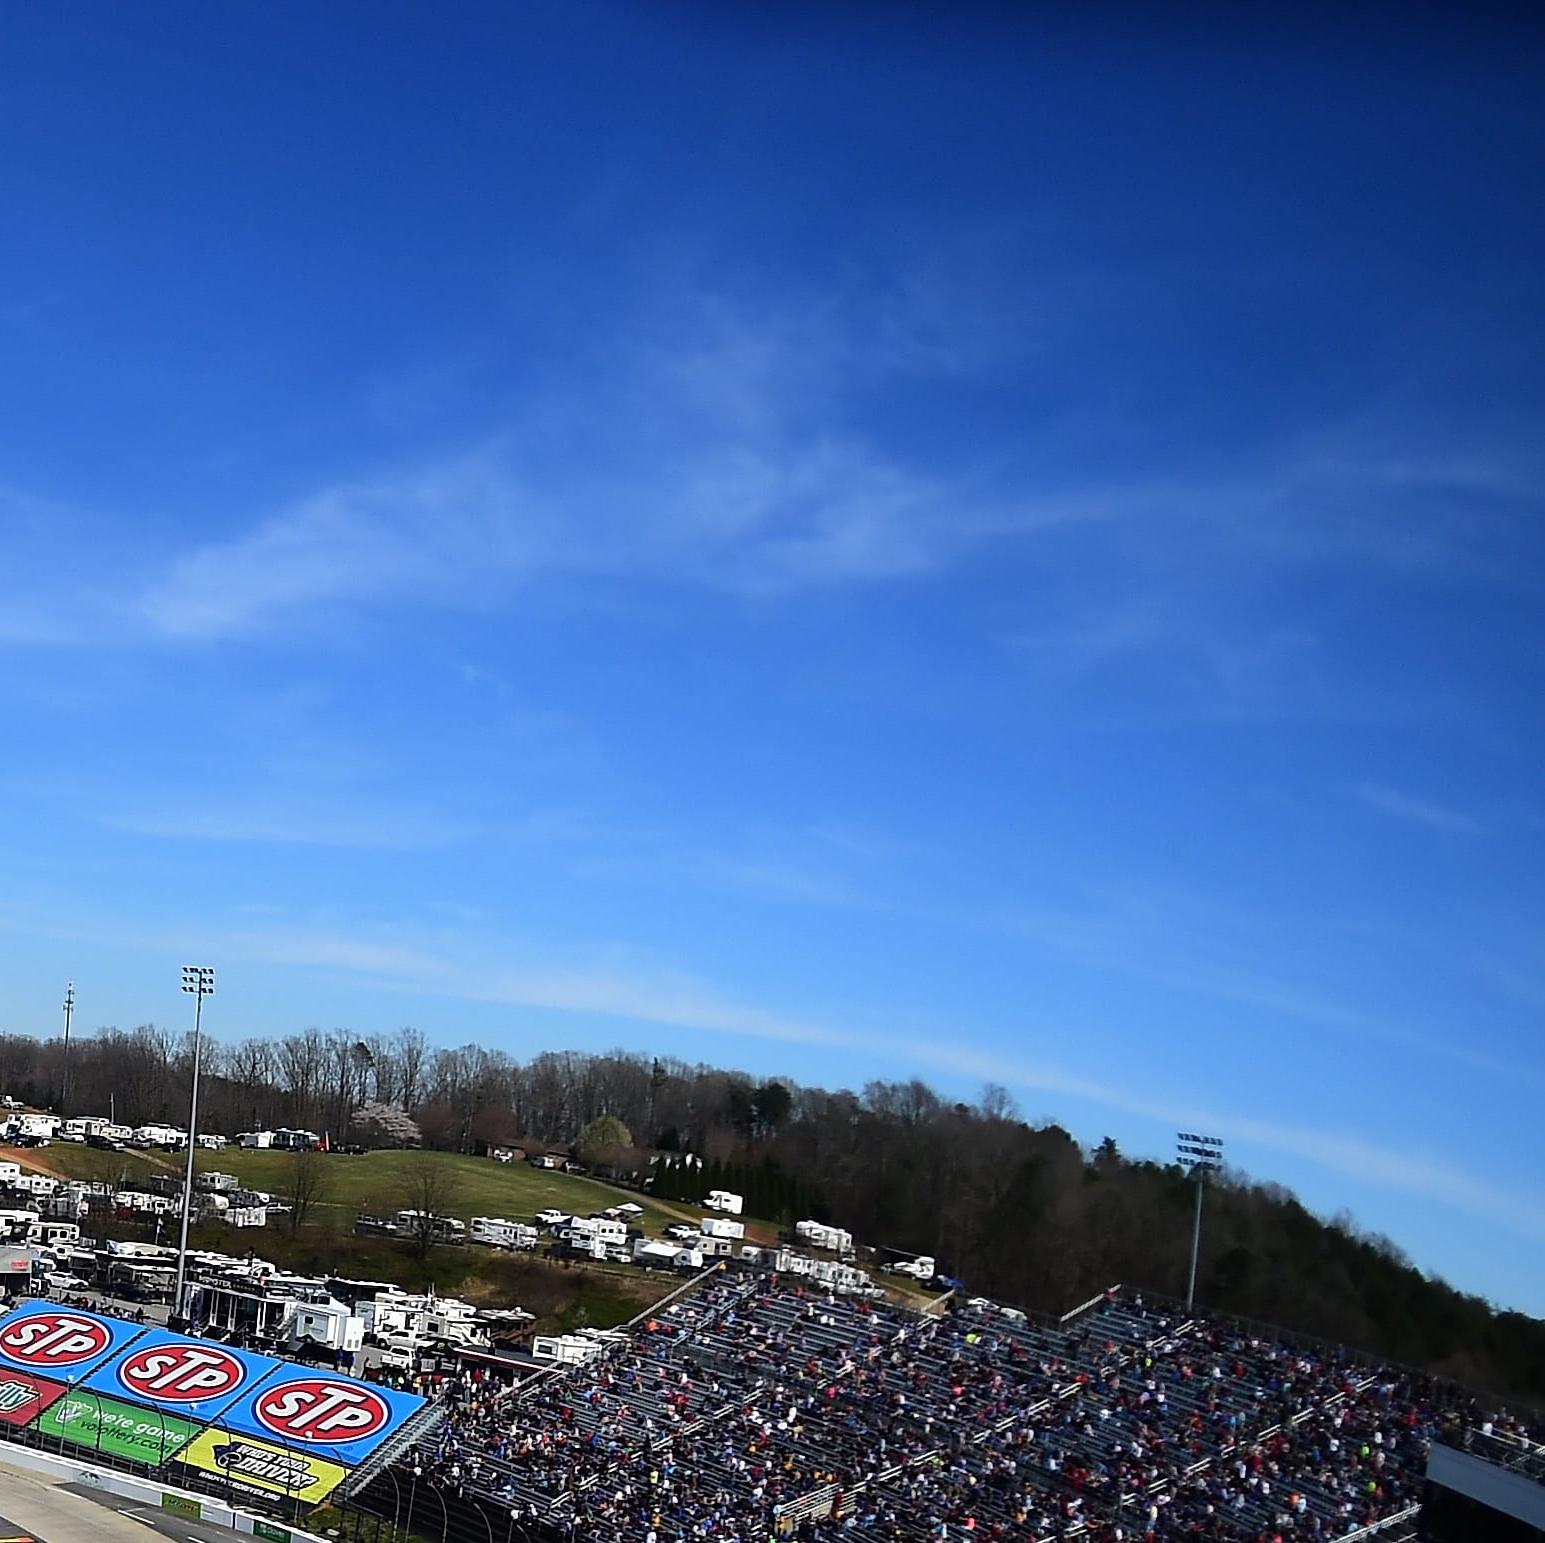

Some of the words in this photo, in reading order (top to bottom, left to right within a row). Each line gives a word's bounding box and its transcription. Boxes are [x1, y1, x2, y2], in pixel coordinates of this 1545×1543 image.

[4, 1318, 97, 1357] STP
[128, 1350, 229, 1393] STP
[91, 1406, 135, 1430] we're
[135, 1421, 186, 1444] game
[264, 1386, 373, 1432] STP
